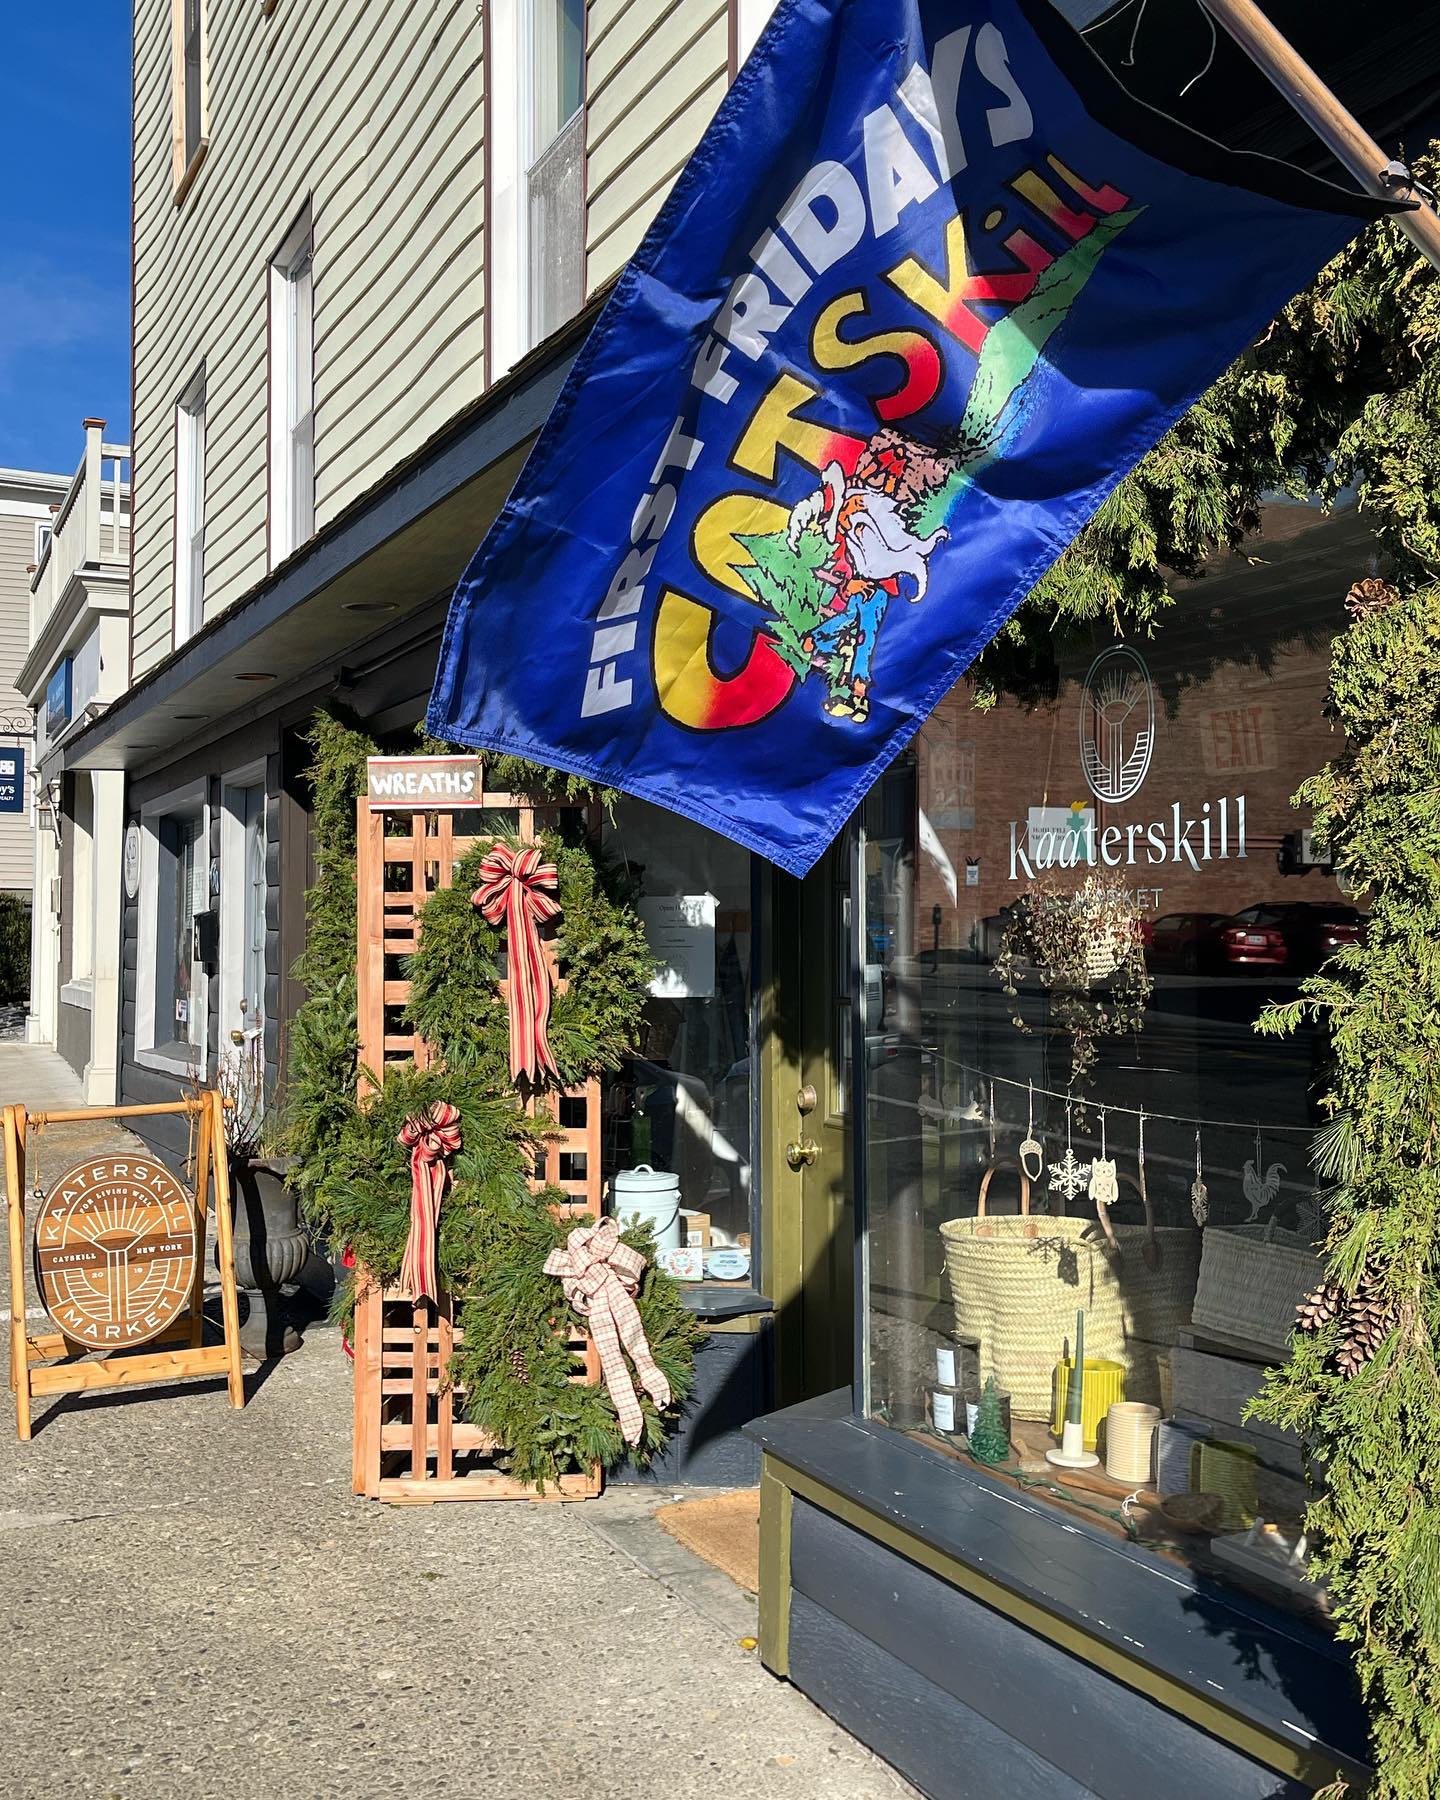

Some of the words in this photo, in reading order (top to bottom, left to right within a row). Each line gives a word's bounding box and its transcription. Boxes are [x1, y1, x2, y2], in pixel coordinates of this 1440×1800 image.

[580, 416, 705, 719] FIRST
[690, 22, 1034, 405] FRIDAYS
[370, 771, 476, 795] WREATHS
[1007, 794, 1249, 881] Kaaterskill
[45, 1164, 185, 1241] KAATERSKILL
[79, 1198, 94, 1214] FOR
[96, 1188, 128, 1199] LIVING
[132, 1190, 152, 1208] WELL
[52, 1253, 97, 1263] CATSKILL
[136, 1246, 156, 1254] NEW
[160, 1243, 183, 1251] YORK
[63, 1296, 173, 1339] MARKET
